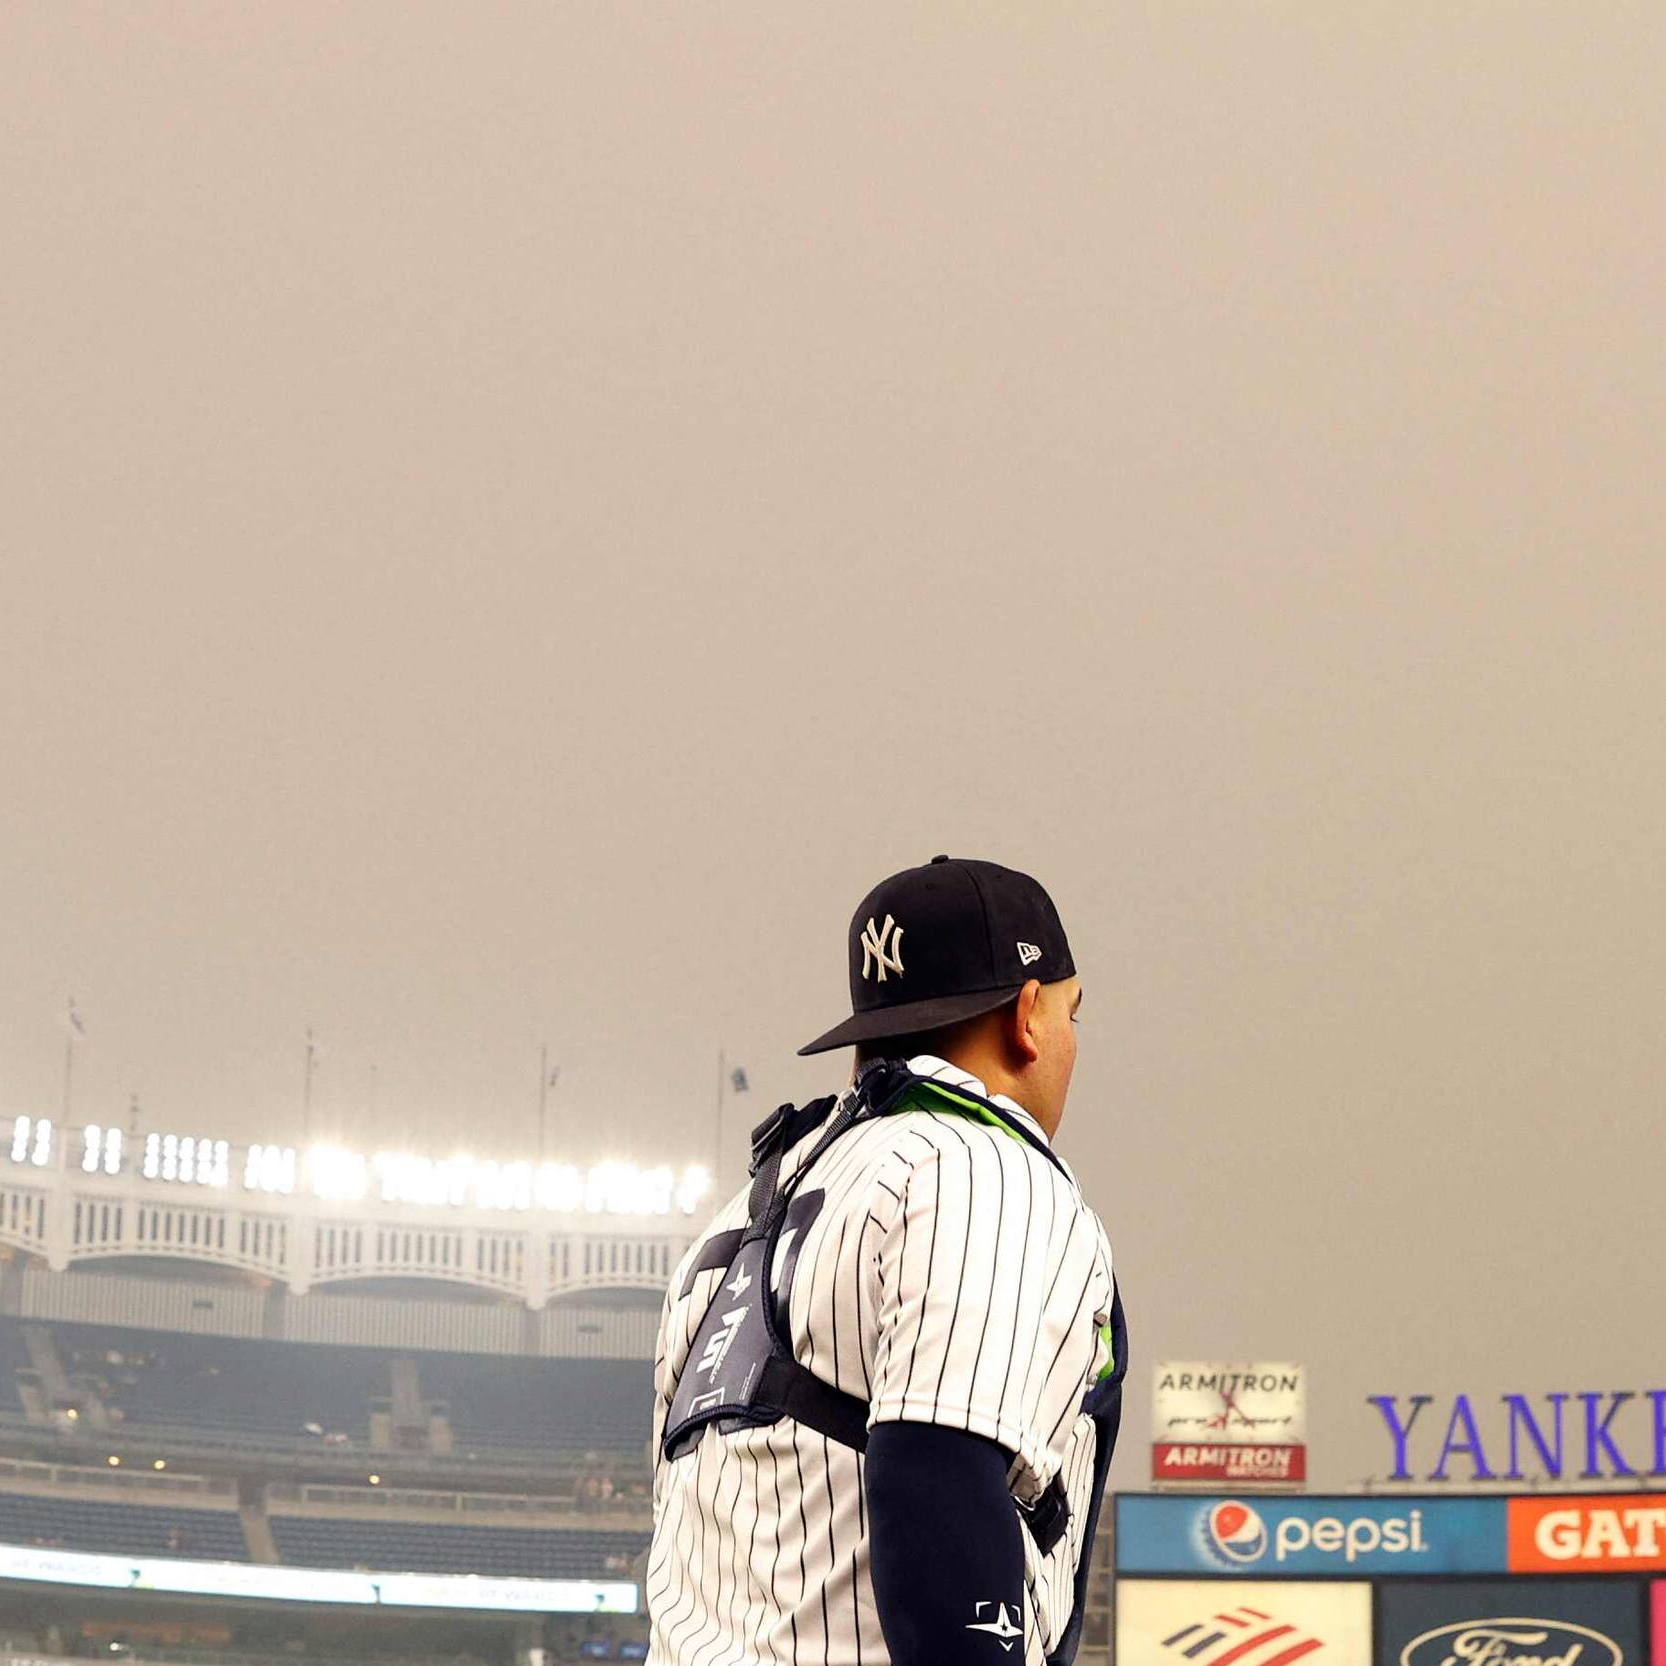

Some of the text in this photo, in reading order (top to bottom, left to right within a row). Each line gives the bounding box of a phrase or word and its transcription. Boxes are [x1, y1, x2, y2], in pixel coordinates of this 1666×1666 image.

[860, 914, 905, 983] NY
[1159, 1373, 1299, 1392] ARMITRON
[1164, 1447, 1292, 1467] ARMITRON
[1276, 1510, 1428, 1563] pepsi
